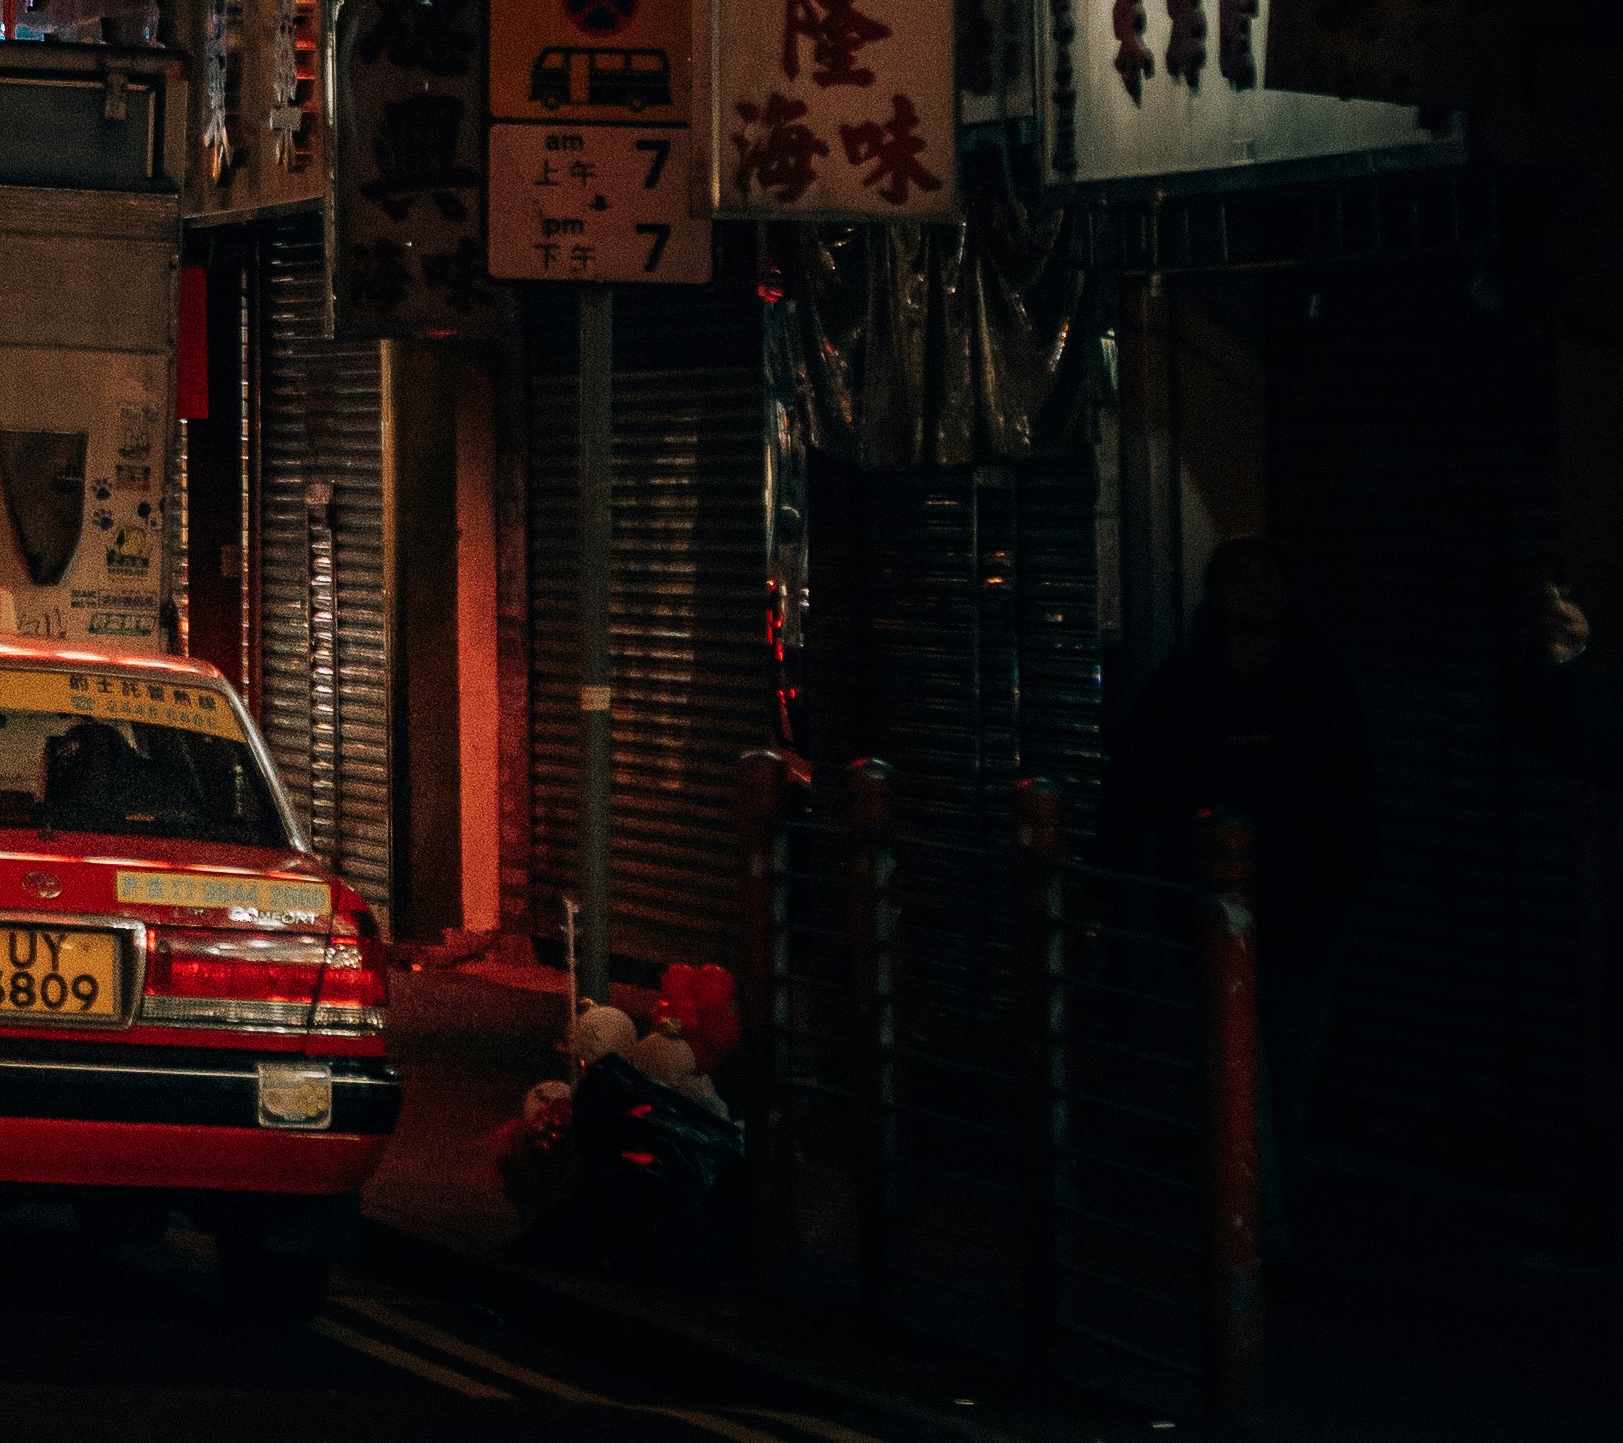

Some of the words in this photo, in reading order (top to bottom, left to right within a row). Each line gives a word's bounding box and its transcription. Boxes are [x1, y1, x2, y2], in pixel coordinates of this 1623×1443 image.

[545, 134, 584, 151] am
[731, 93, 942, 204] 海味
[533, 159, 597, 188] 上午
[636, 140, 671, 189] 7
[543, 218, 584, 239] pm
[533, 244, 597, 272] 下午
[636, 223, 671, 272] 7
[8, 930, 68, 972] UY
